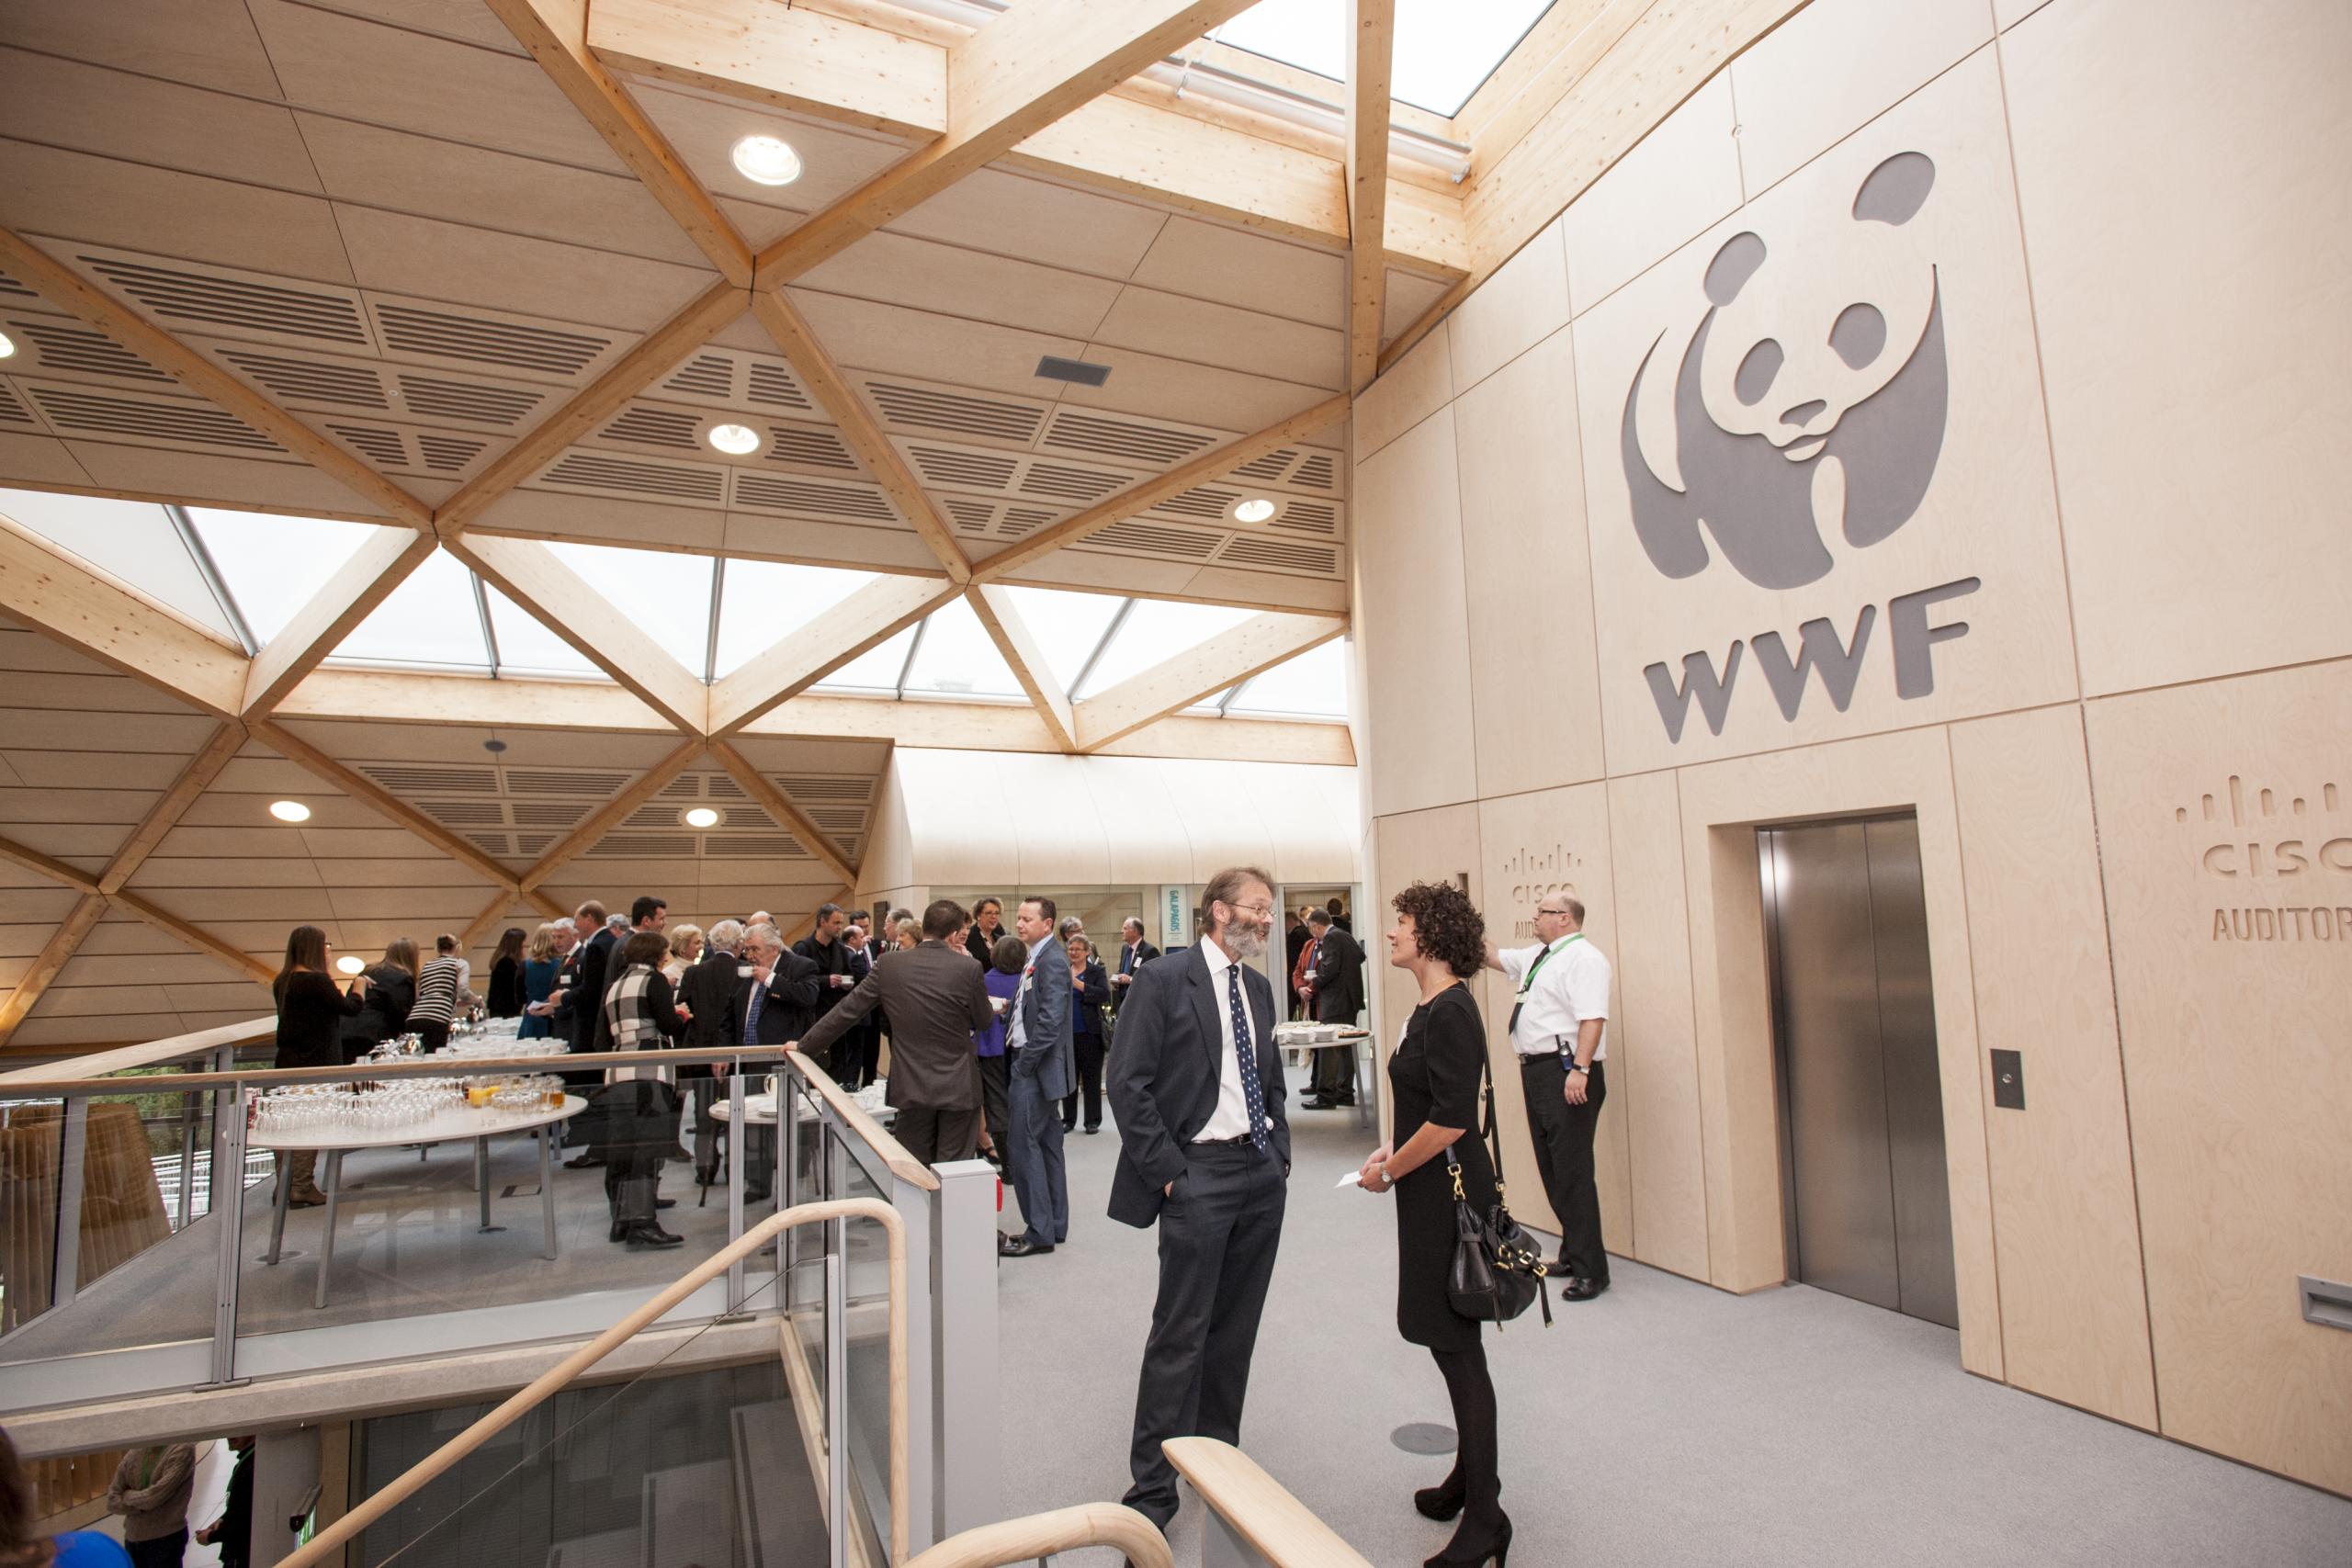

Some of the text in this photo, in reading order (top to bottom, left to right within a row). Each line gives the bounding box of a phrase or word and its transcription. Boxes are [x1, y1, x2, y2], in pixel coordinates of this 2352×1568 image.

[1643, 576, 1982, 745] WWF
[1169, 890, 1181, 931] GALAPAGOS
[2212, 907, 2352, 942] AUDITOR
